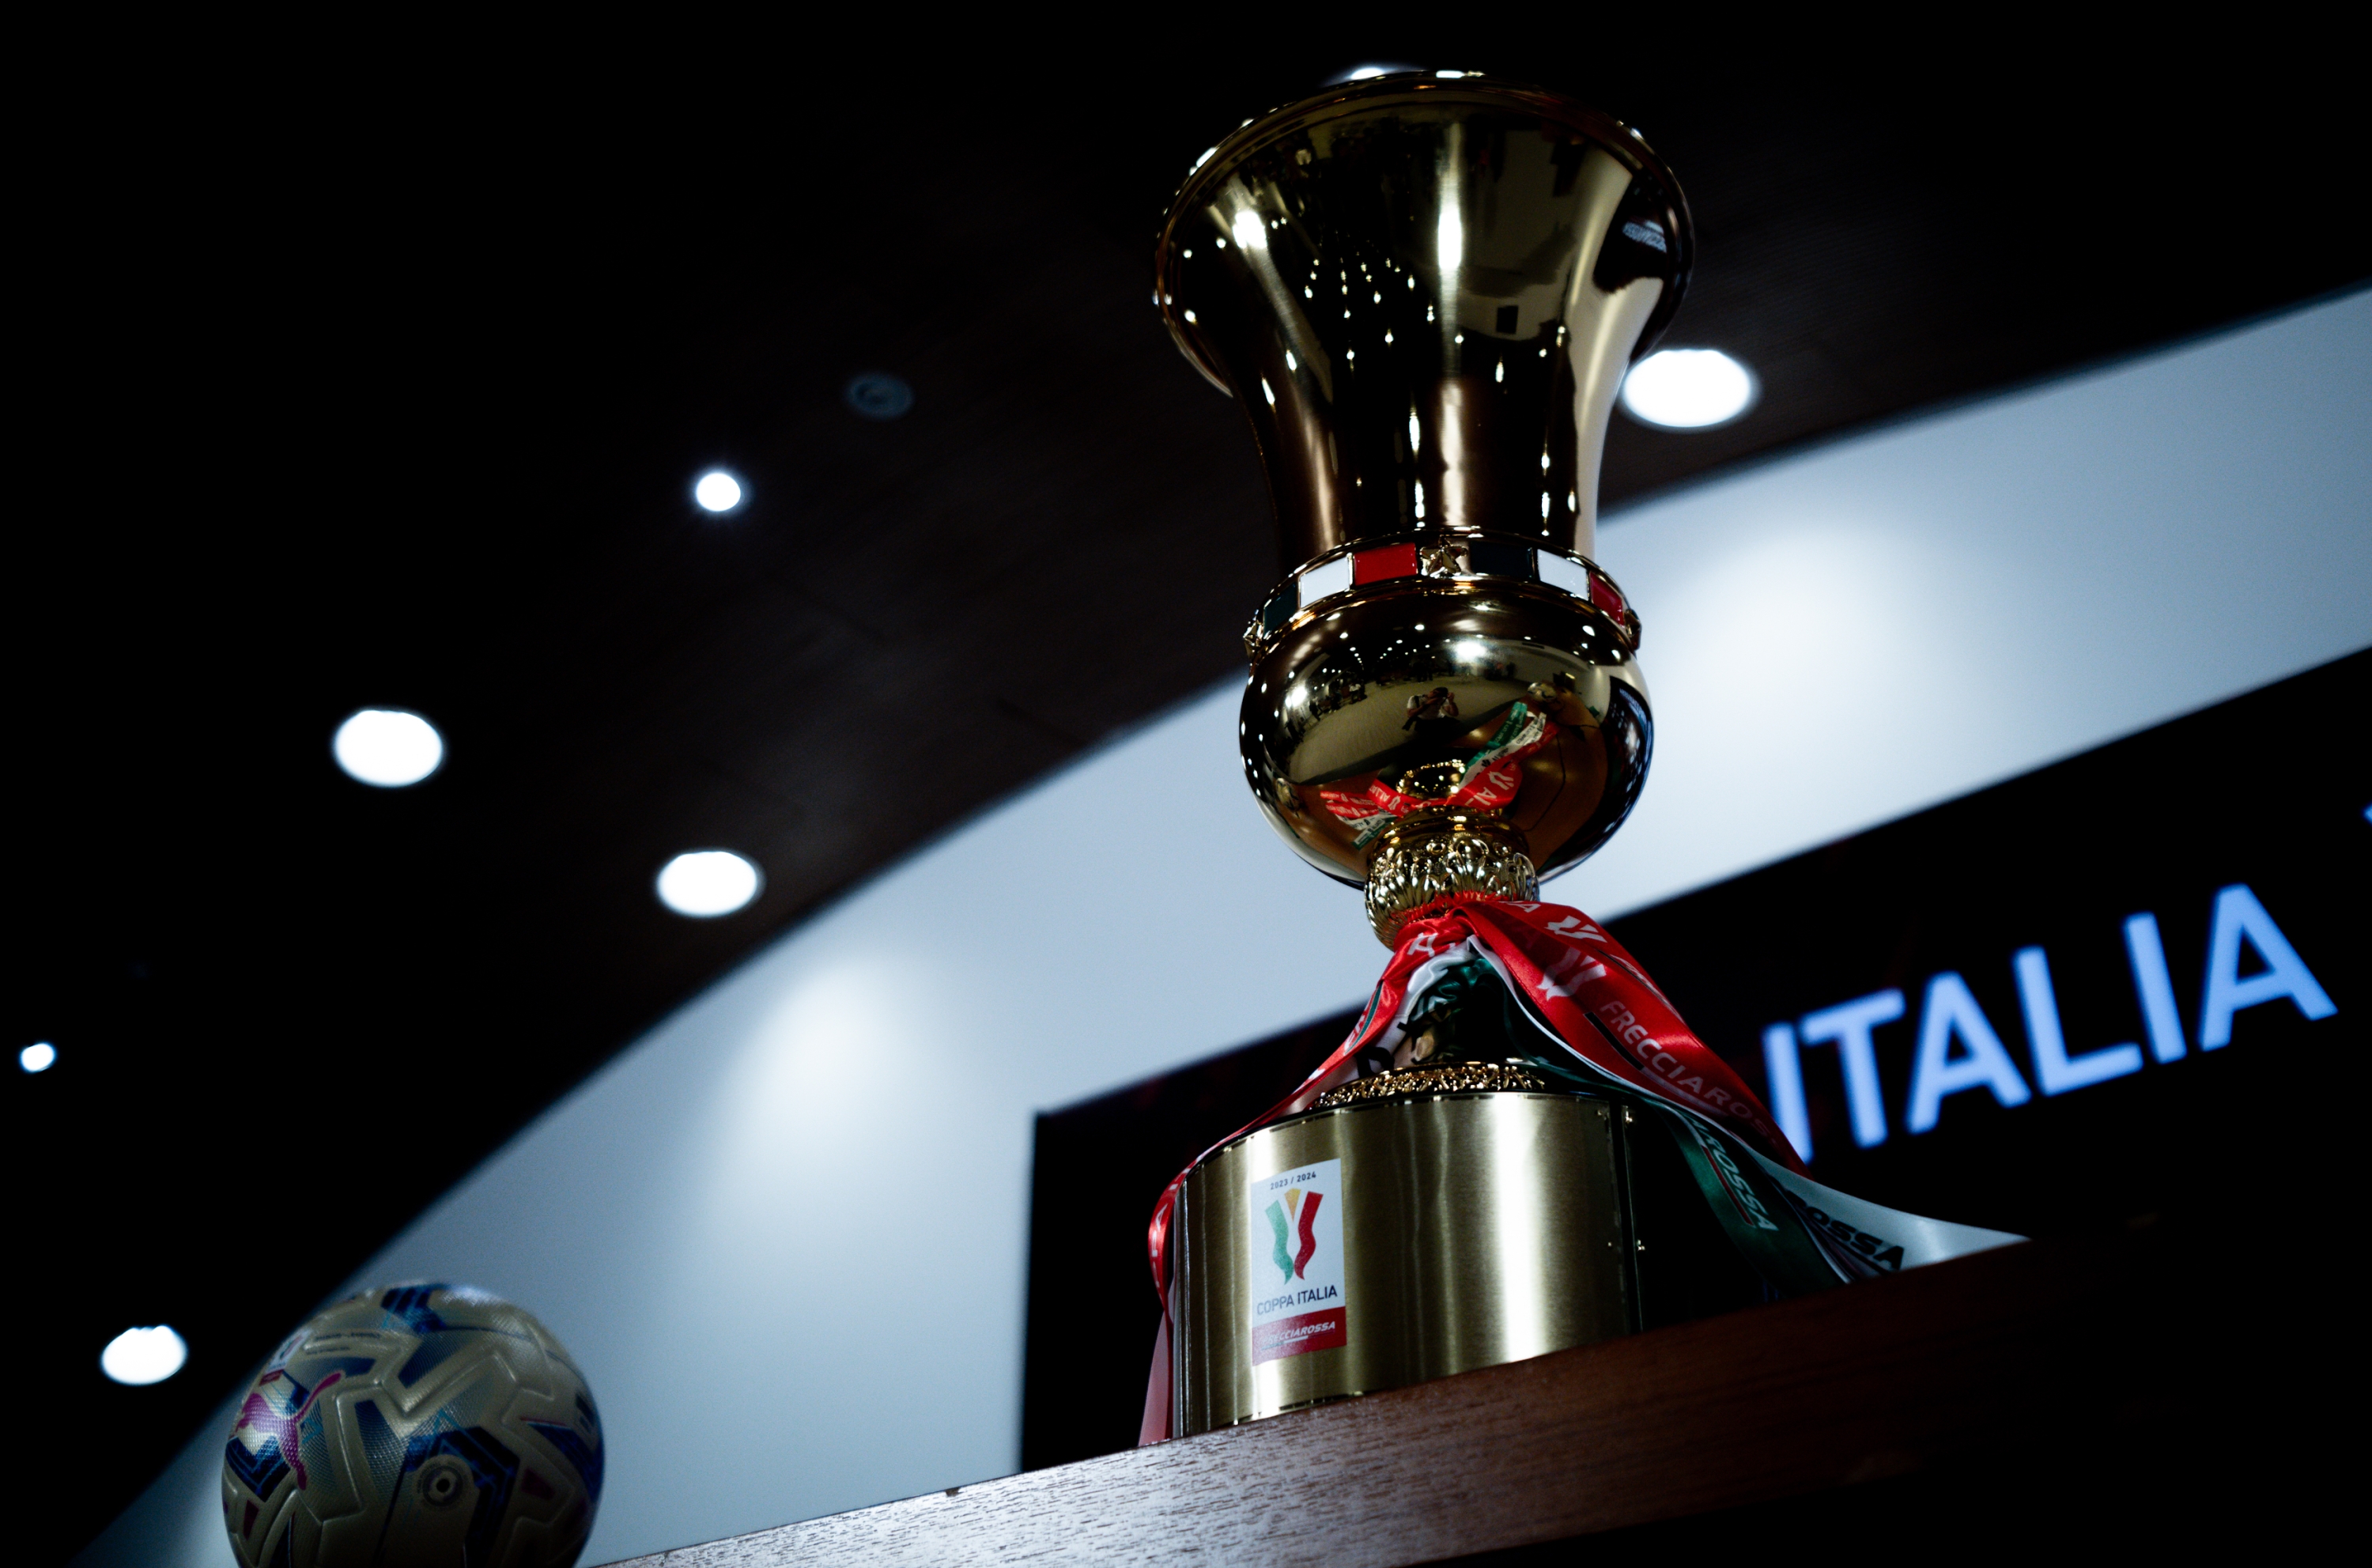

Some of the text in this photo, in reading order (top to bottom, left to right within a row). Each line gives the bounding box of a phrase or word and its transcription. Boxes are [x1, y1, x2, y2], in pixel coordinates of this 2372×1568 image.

[1762, 881, 2340, 1166] ITALIA
[1270, 1178, 1288, 1190] 2023
[1297, 1171, 1316, 1182] 2024
[1256, 1284, 1338, 1315] COPPA ITALIA
